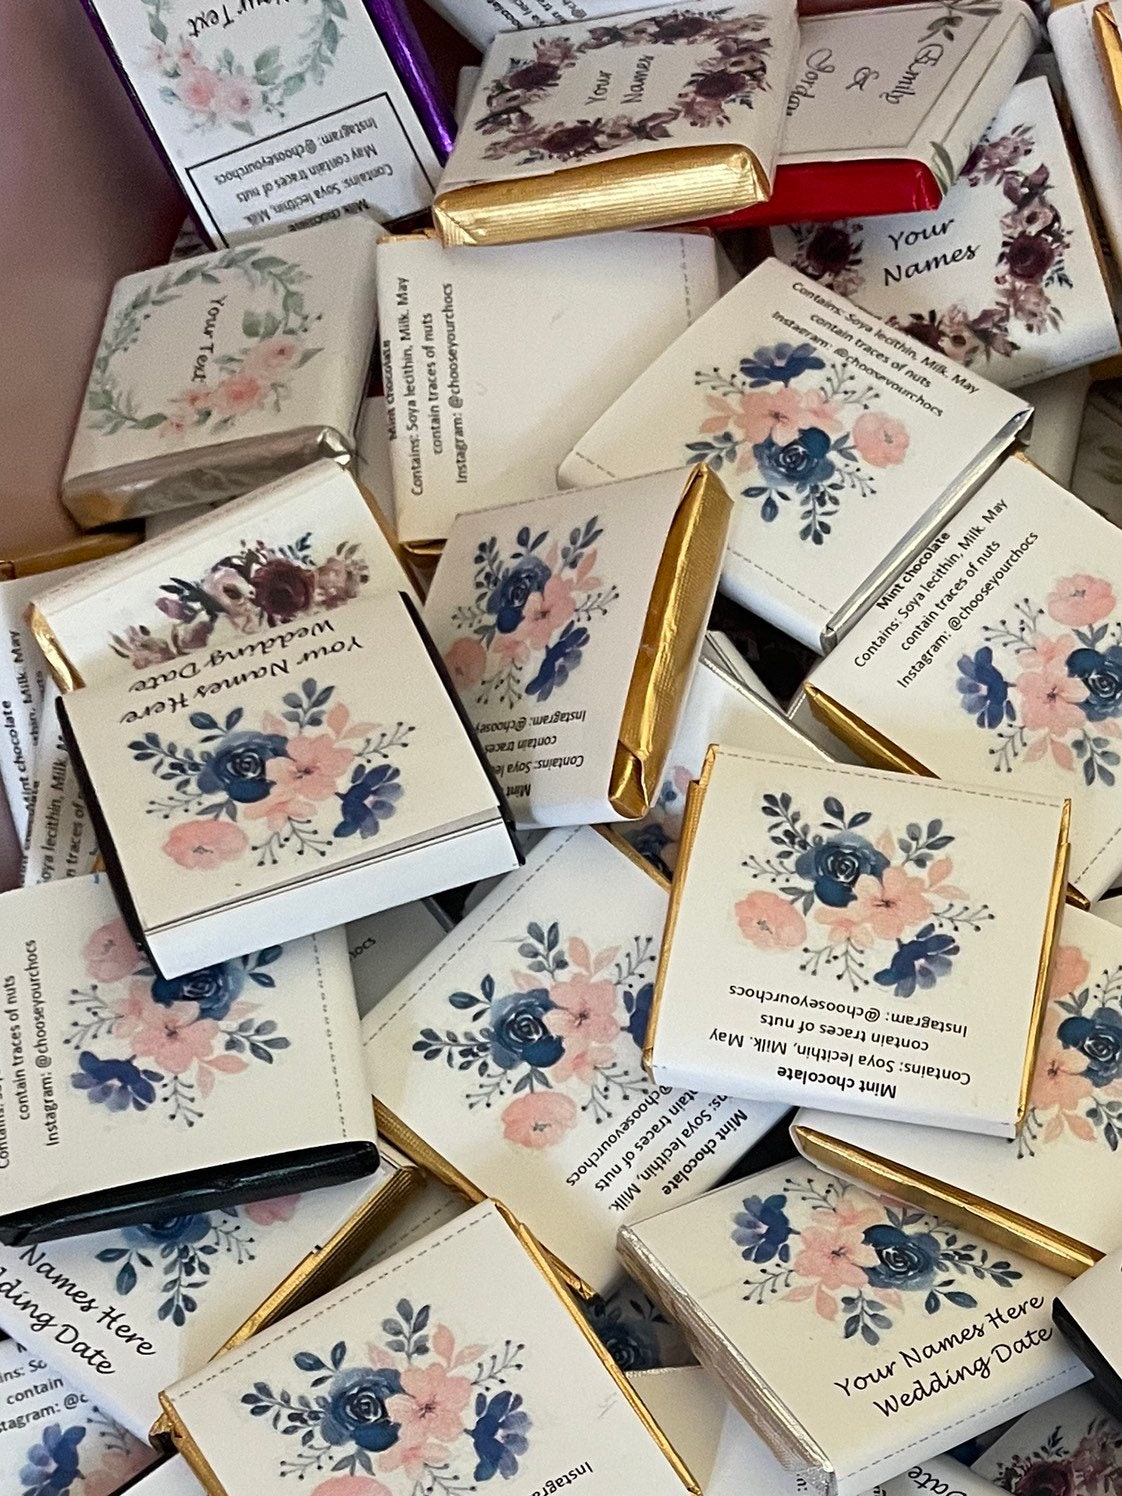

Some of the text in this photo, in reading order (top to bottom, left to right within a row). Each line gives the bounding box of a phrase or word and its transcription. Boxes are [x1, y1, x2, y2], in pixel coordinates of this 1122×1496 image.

[214, 138, 317, 186] @chooseyourchocs
[883, 244, 980, 287] Names
[887, 218, 955, 251] Your
[440, 283, 468, 484] Instagram: @chooseyourchocs
[854, 498, 1008, 668] Contains: Soya lecithin, Milk. May
[875, 532, 951, 610] Mint chocolate
[896, 532, 1039, 689] Instagram: @chooseyourchocs
[901, 540, 1001, 651] contain traces of nuts
[119, 635, 363, 724] Your Names Here
[128, 619, 335, 693] Wedding Date
[23, 939, 60, 1147] Instagram: @chooseyourchocs
[729, 985, 968, 1038] Instagram: @chooseyourchocs
[760, 1014, 929, 1051] contain traces of nuts
[709, 1028, 971, 1086] Contains: Soya lecithin, Milk. May
[777, 1066, 897, 1099] Mint chocolate
[661, 1109, 748, 1195] Mint chocolate
[19, 1245, 157, 1356] Names Here
[54, 1323, 116, 1375] Date
[833, 1296, 1045, 1397] Your Names Here
[872, 1328, 1053, 1417] Wedding Date
